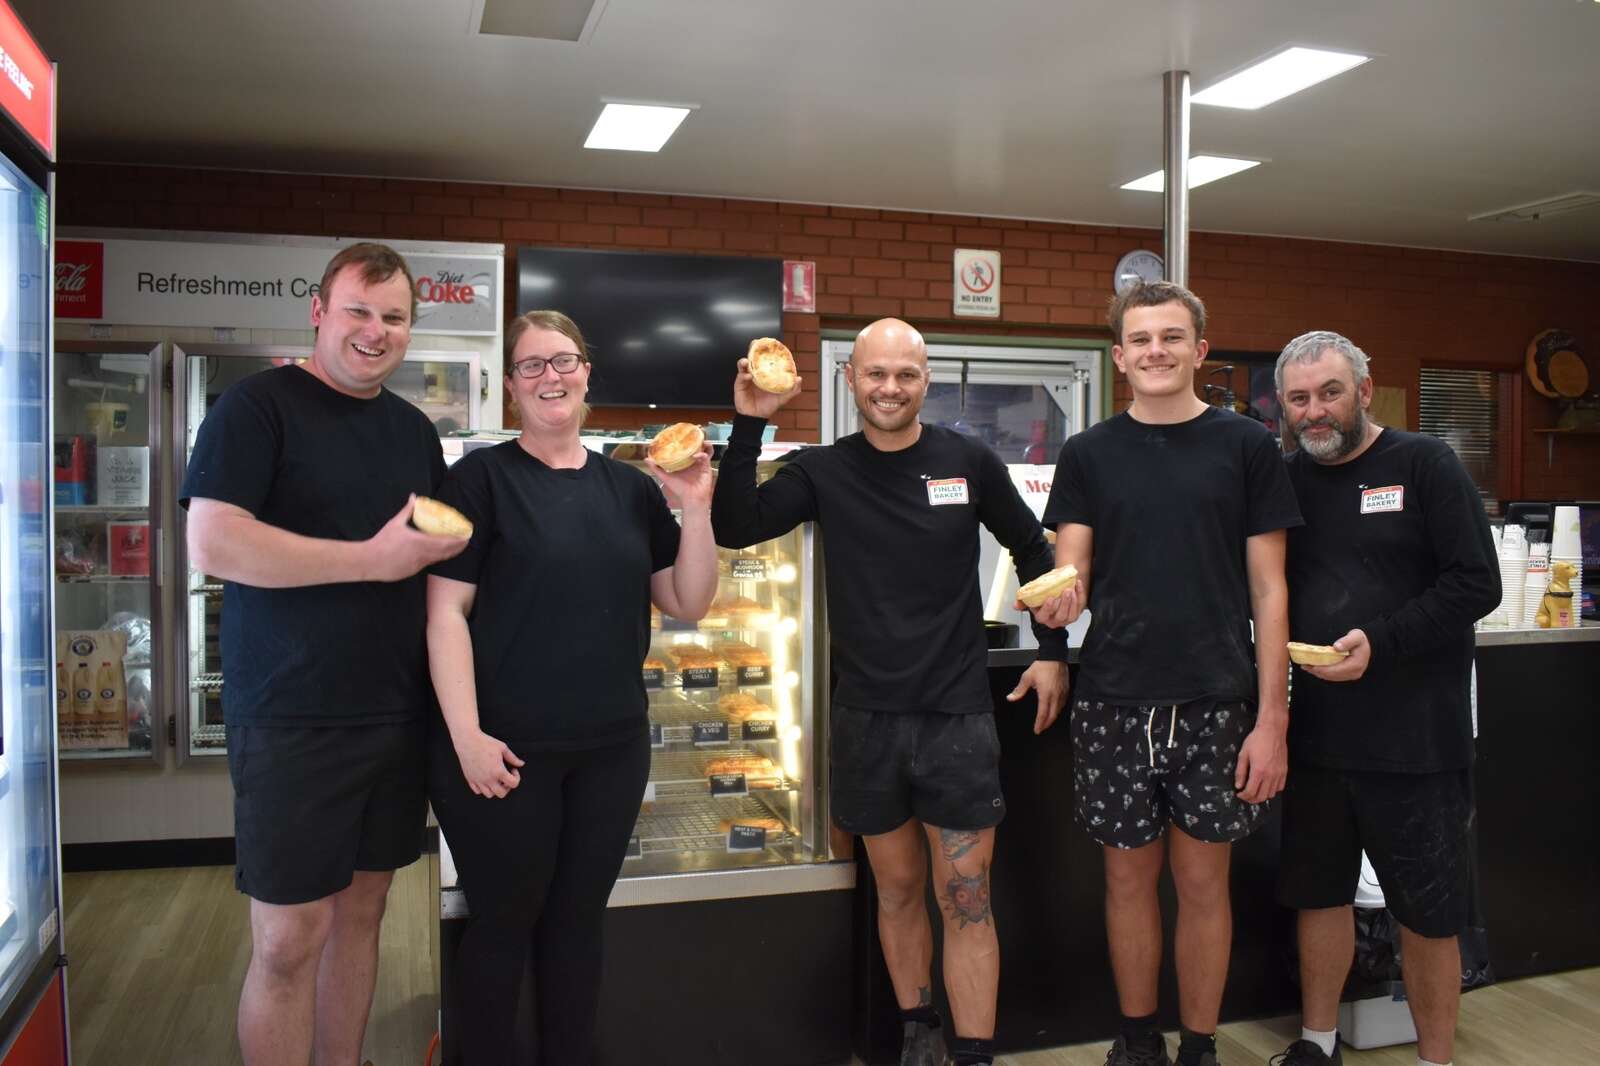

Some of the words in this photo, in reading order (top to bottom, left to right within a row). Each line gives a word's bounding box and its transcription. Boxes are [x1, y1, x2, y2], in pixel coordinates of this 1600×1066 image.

[436, 271, 464, 283] Diet
[137, 272, 284, 297] Refreshment
[415, 275, 475, 305] Coke
[972, 295, 993, 303] ENTRY
[933, 485, 962, 493] FINLEY
[1367, 492, 1397, 502] FINLEY
[1366, 499, 1396, 508] BAKERY
